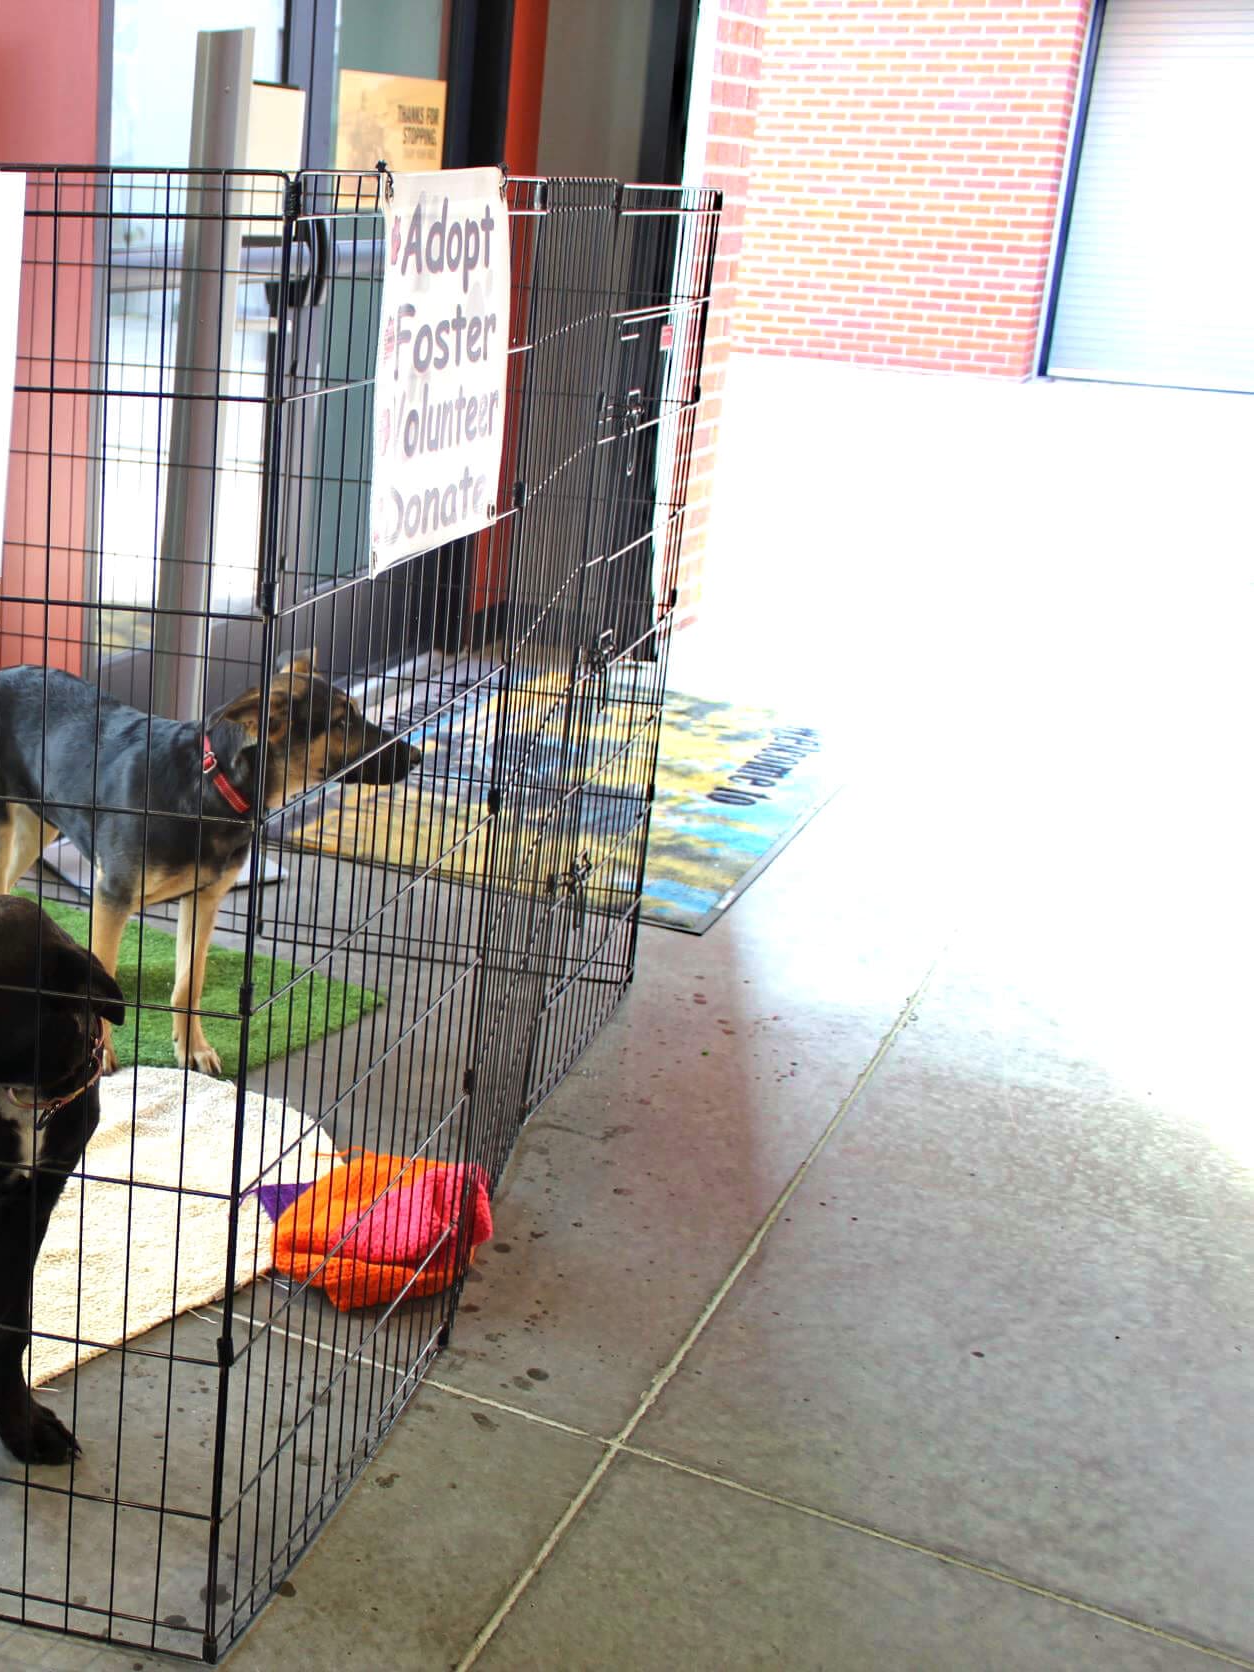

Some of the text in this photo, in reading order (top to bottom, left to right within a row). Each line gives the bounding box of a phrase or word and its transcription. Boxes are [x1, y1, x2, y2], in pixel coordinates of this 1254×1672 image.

[398, 104, 439, 125] THANKS FOR
[401, 197, 494, 293] Adopt
[393, 303, 496, 381] Foster
[394, 382, 498, 458] Volunteer
[384, 465, 486, 544] Donate
